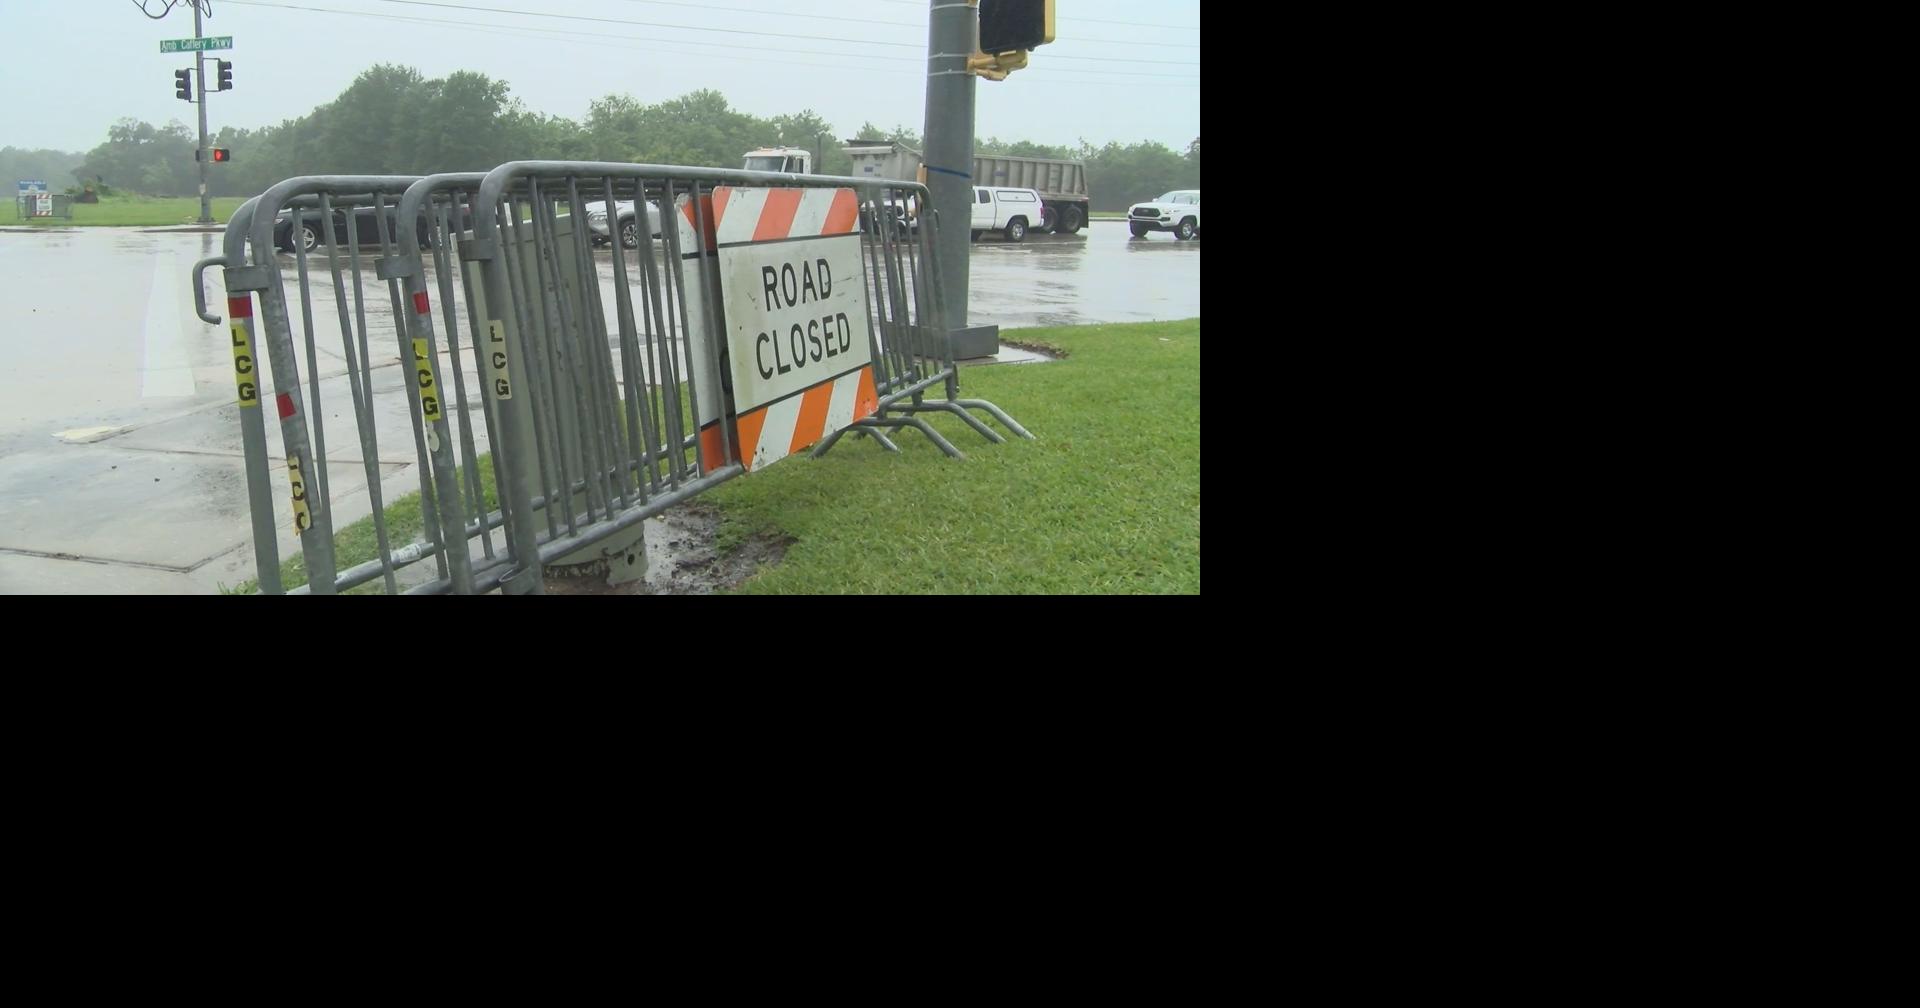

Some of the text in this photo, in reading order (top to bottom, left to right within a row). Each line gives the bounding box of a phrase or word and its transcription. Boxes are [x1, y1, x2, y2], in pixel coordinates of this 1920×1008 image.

[161, 41, 177, 50] Amb
[211, 37, 231, 49] Pkwy
[762, 258, 832, 311] ROAD
[231, 328, 257, 402] LCG
[489, 325, 510, 396] LCG
[756, 312, 851, 380] CLOSED
